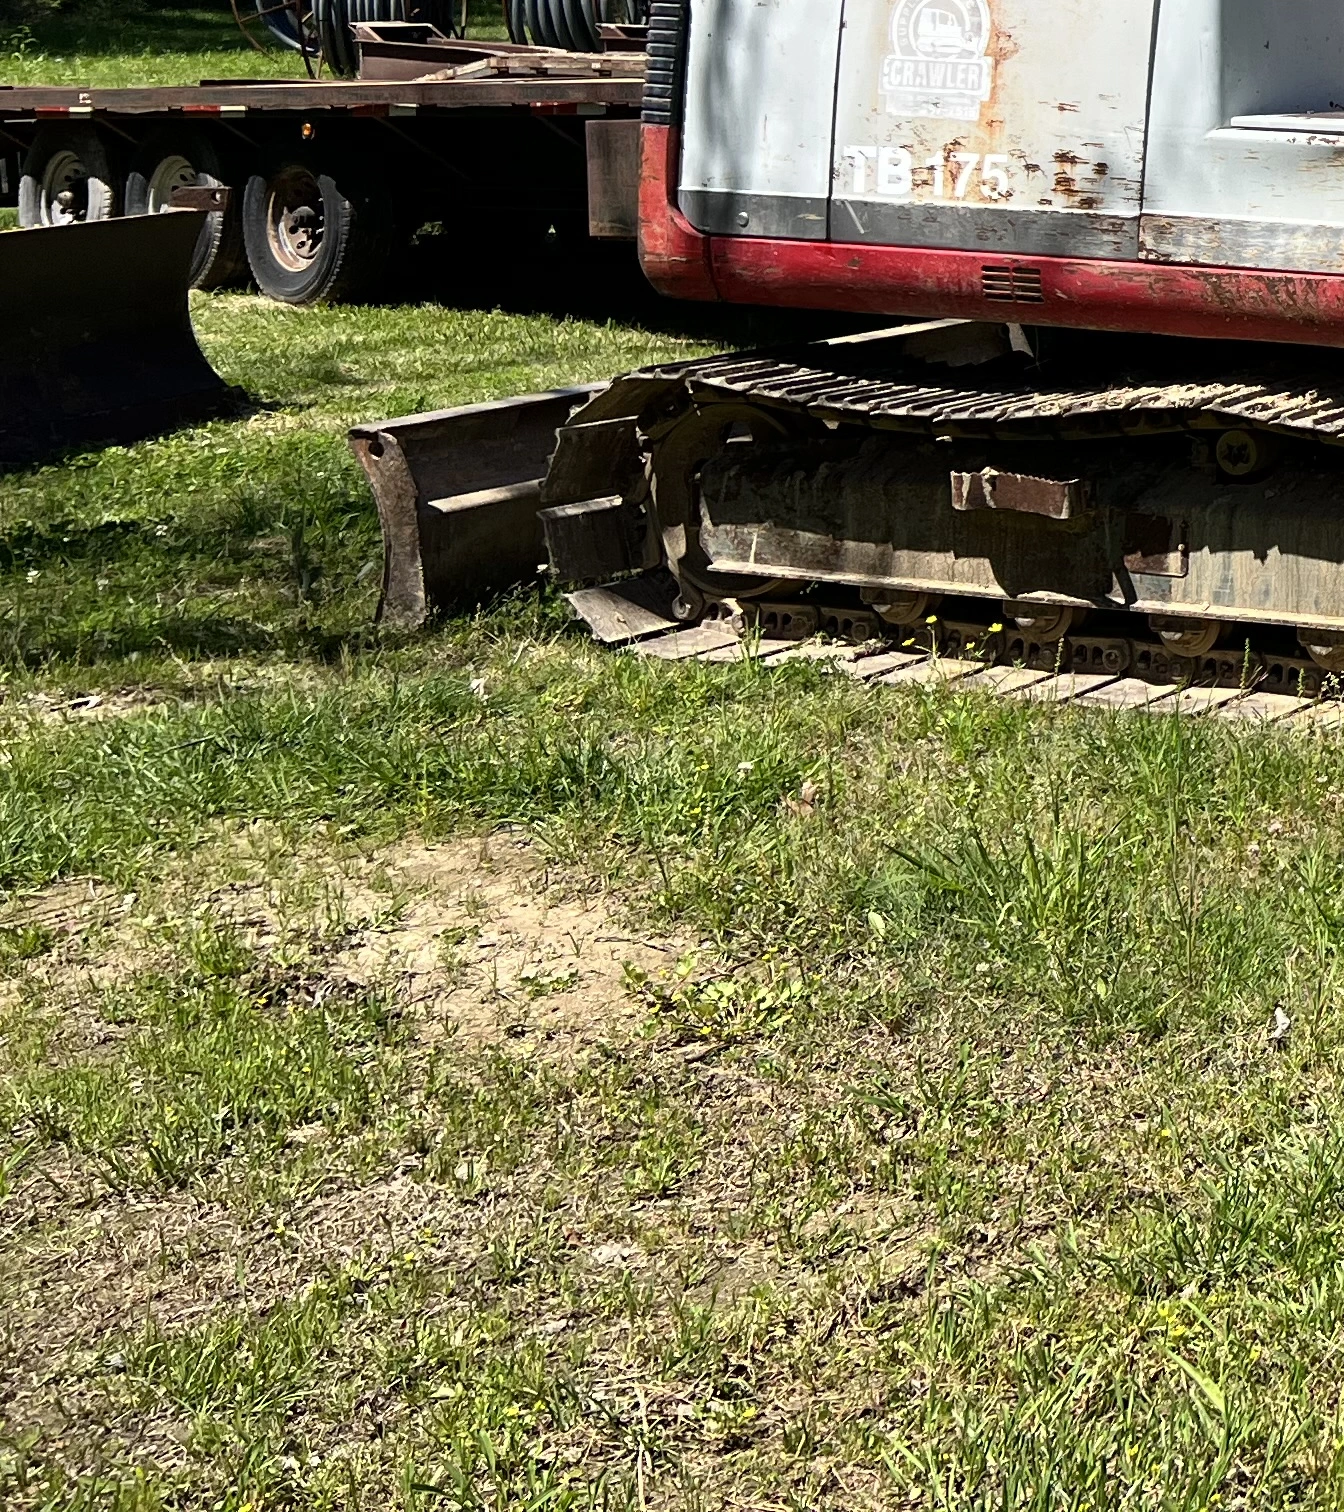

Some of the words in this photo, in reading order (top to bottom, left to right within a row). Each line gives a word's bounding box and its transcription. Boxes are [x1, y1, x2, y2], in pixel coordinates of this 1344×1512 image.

[889, 59, 980, 90] CRAWLER
[843, 145, 912, 195] TB
[925, 150, 1013, 200] 175
